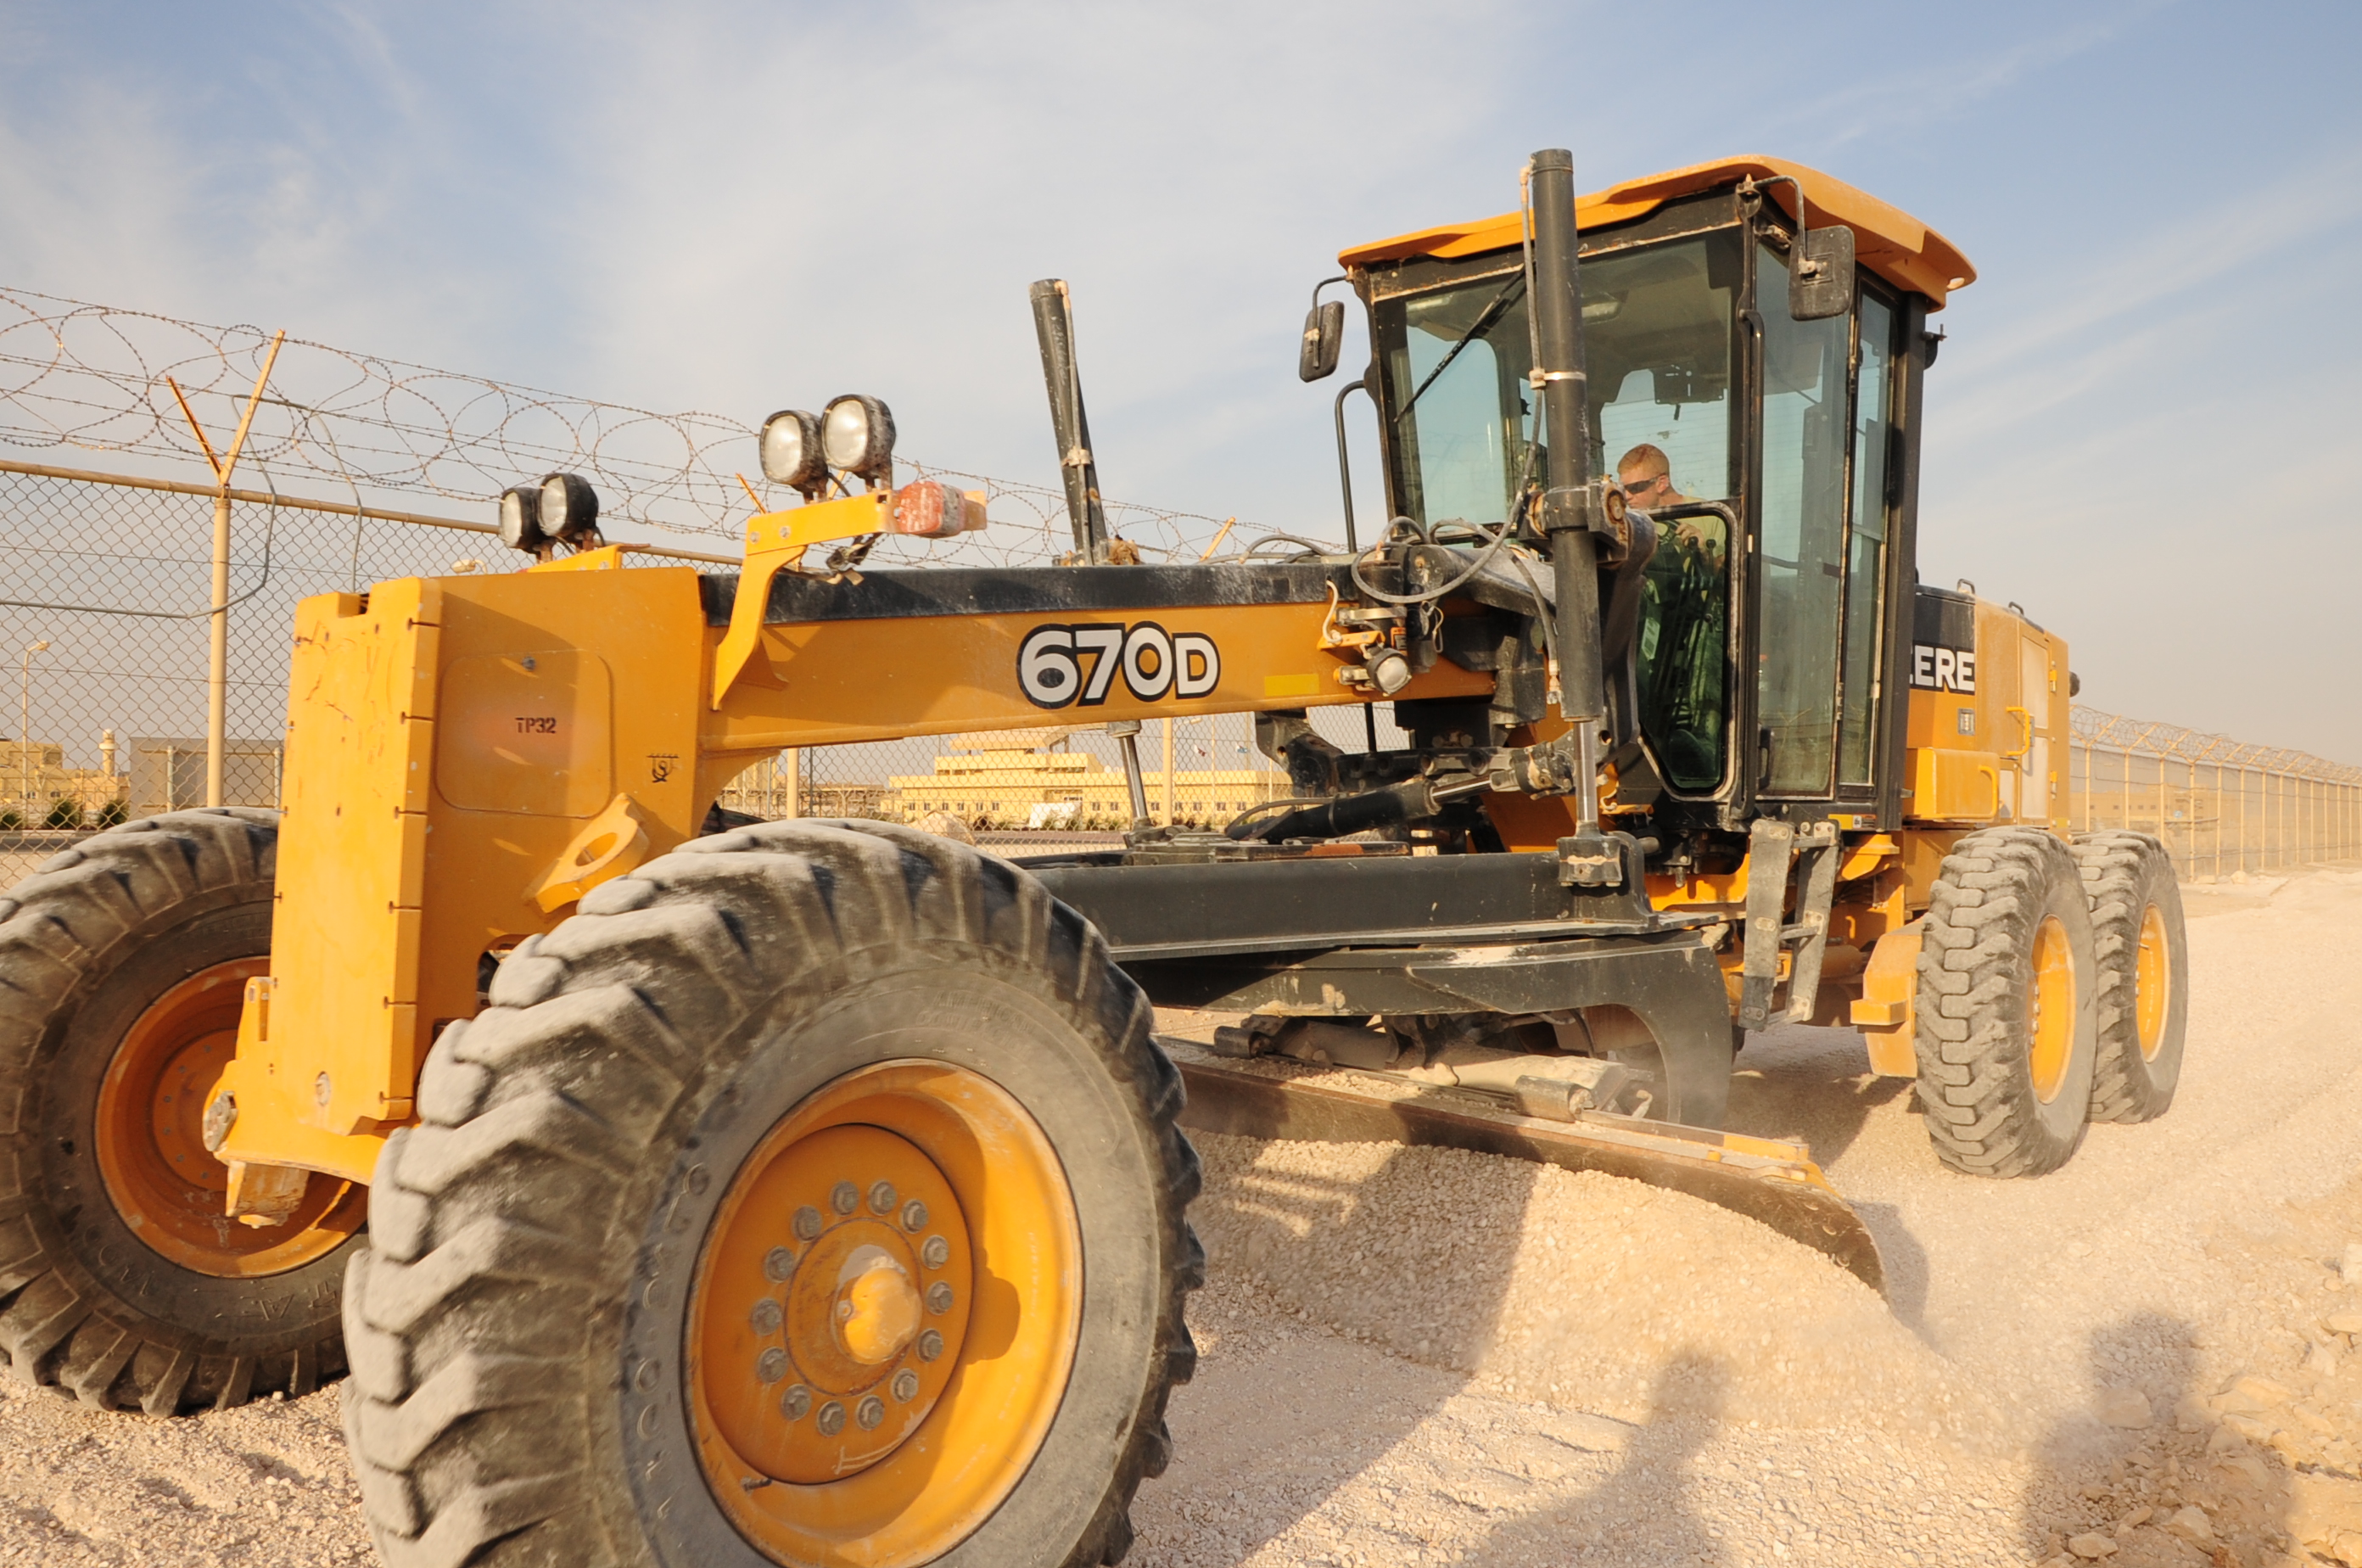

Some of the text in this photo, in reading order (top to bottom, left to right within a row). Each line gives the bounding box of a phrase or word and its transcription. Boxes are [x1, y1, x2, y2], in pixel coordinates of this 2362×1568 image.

[1016, 621, 1221, 709] 670D
[1910, 645, 1975, 692] ERE
[515, 717, 557, 734] TP32
